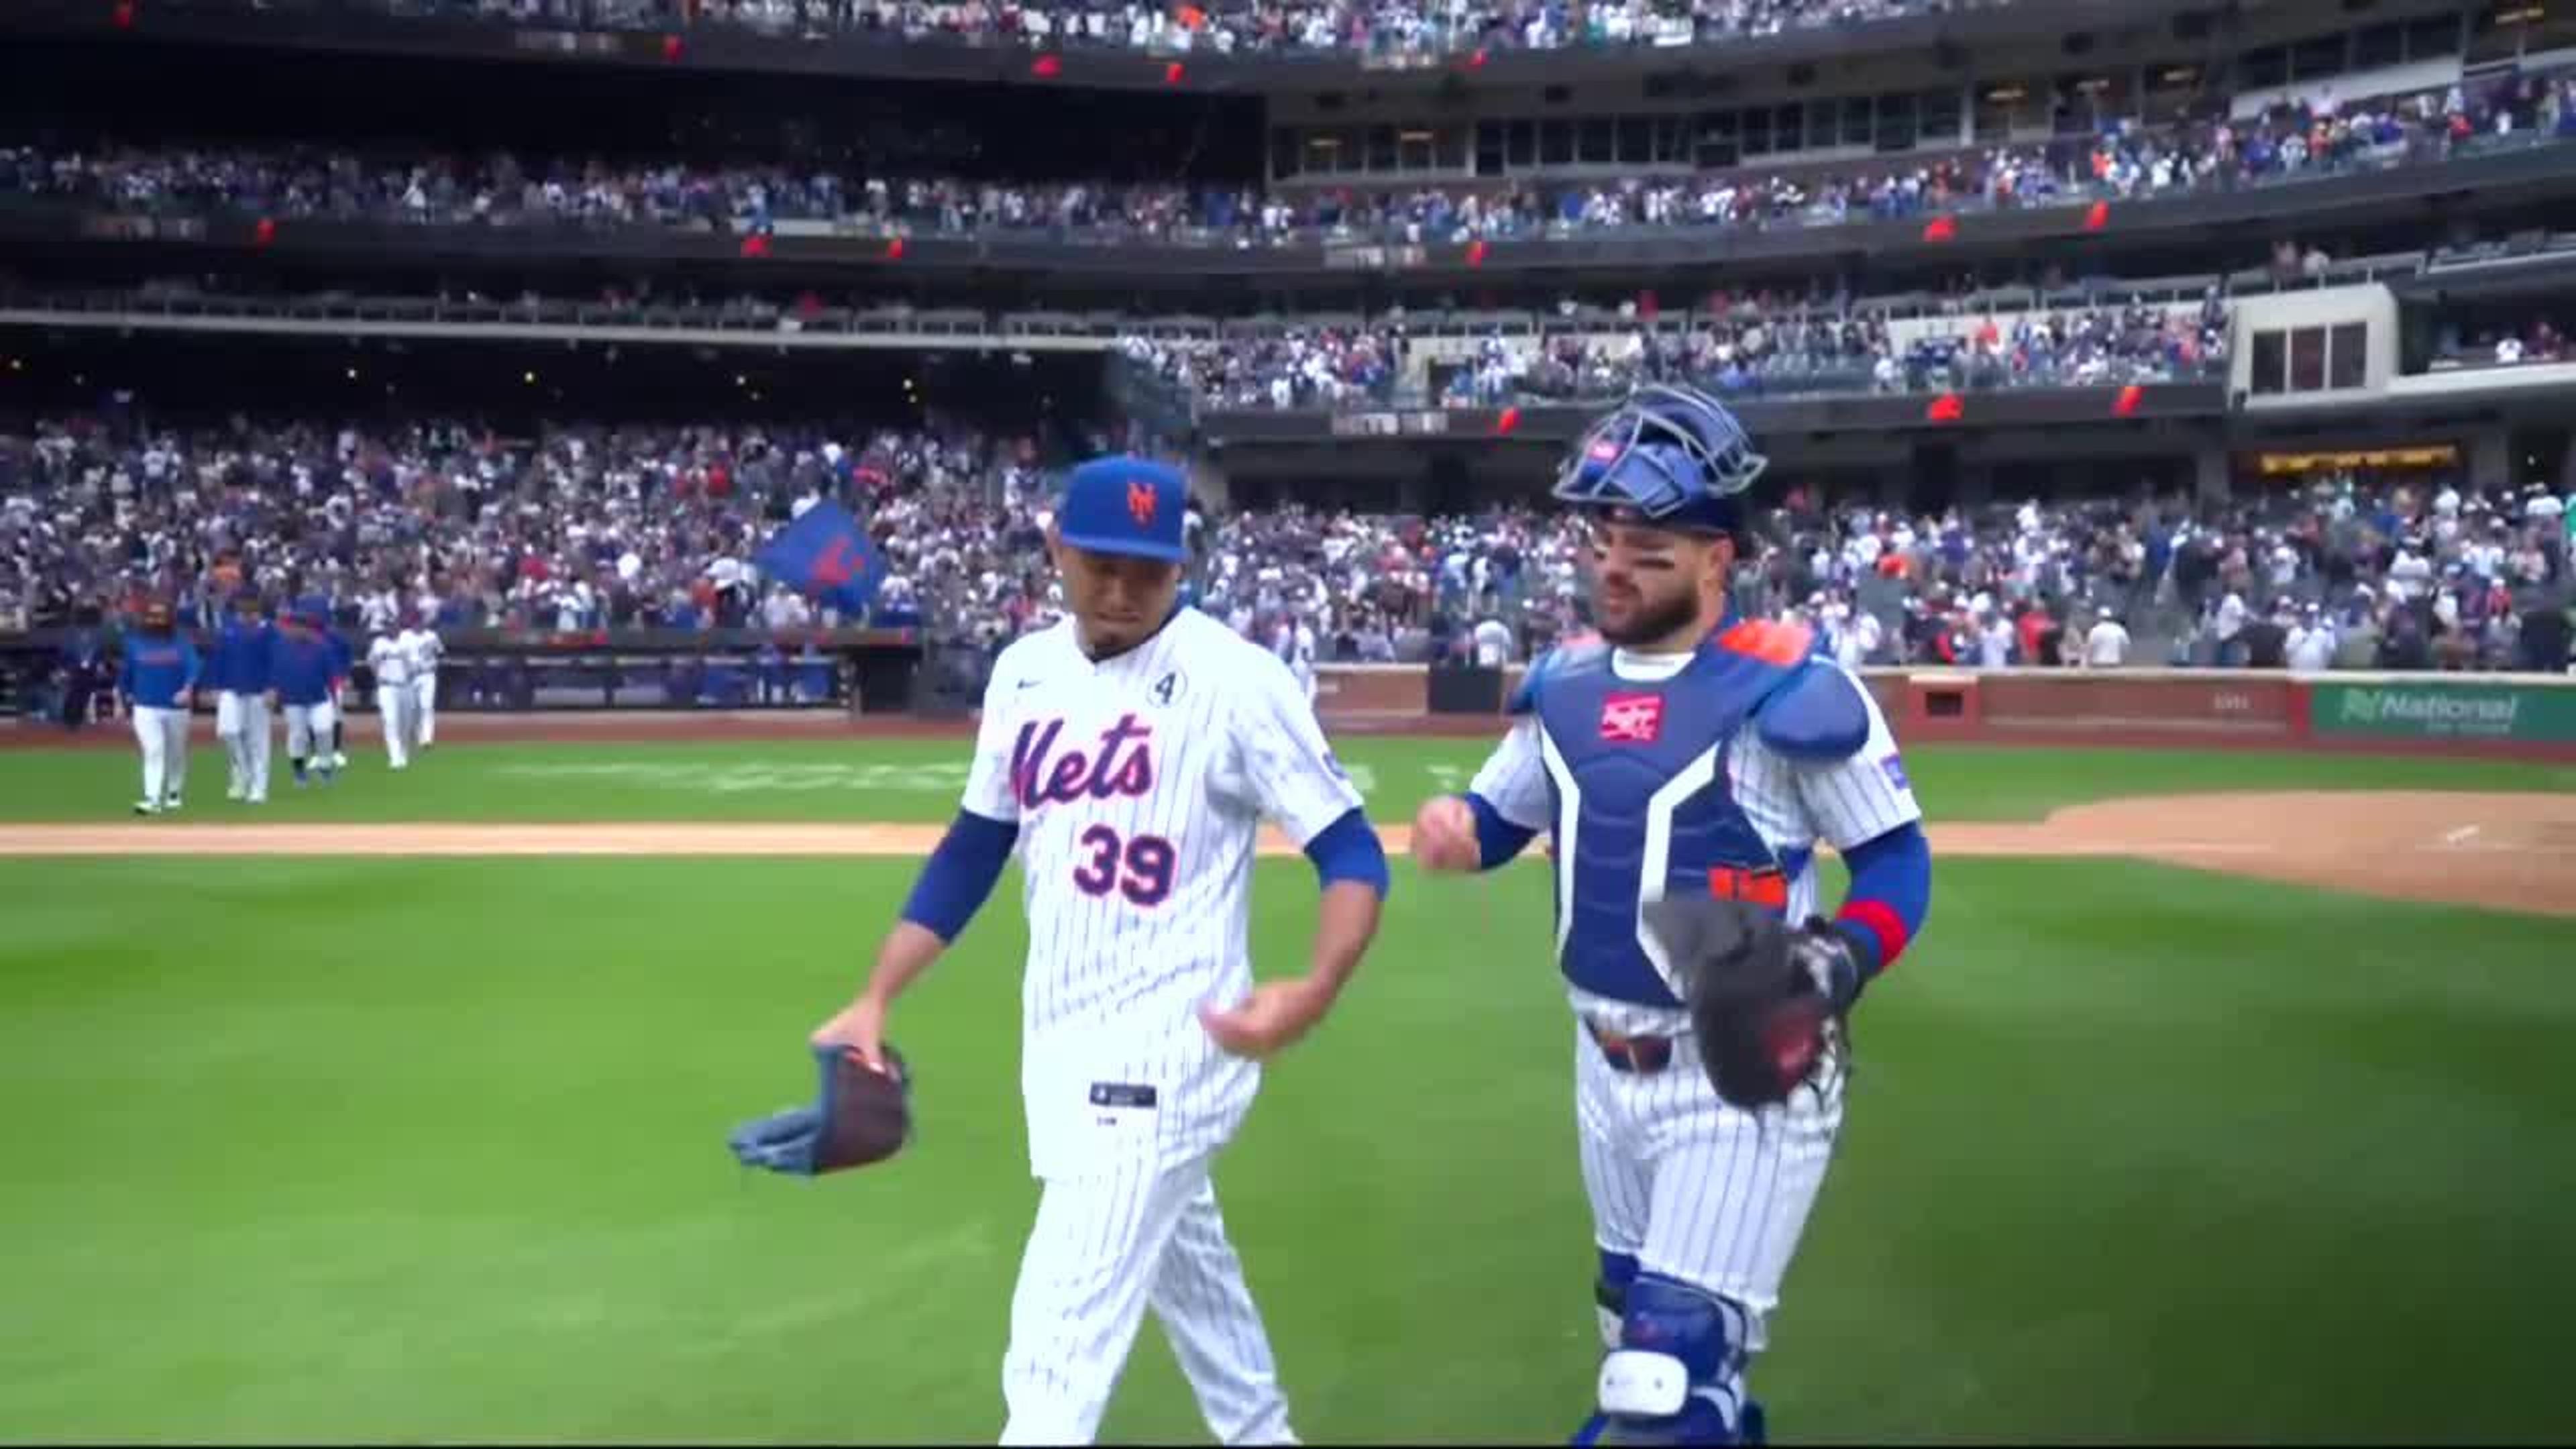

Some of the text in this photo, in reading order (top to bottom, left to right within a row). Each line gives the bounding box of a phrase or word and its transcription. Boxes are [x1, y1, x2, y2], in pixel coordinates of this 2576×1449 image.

[1155, 671, 1176, 705] 4
[2382, 692, 2519, 720] National
[1010, 712, 1153, 810] Mets
[1073, 823, 1177, 908] 39
